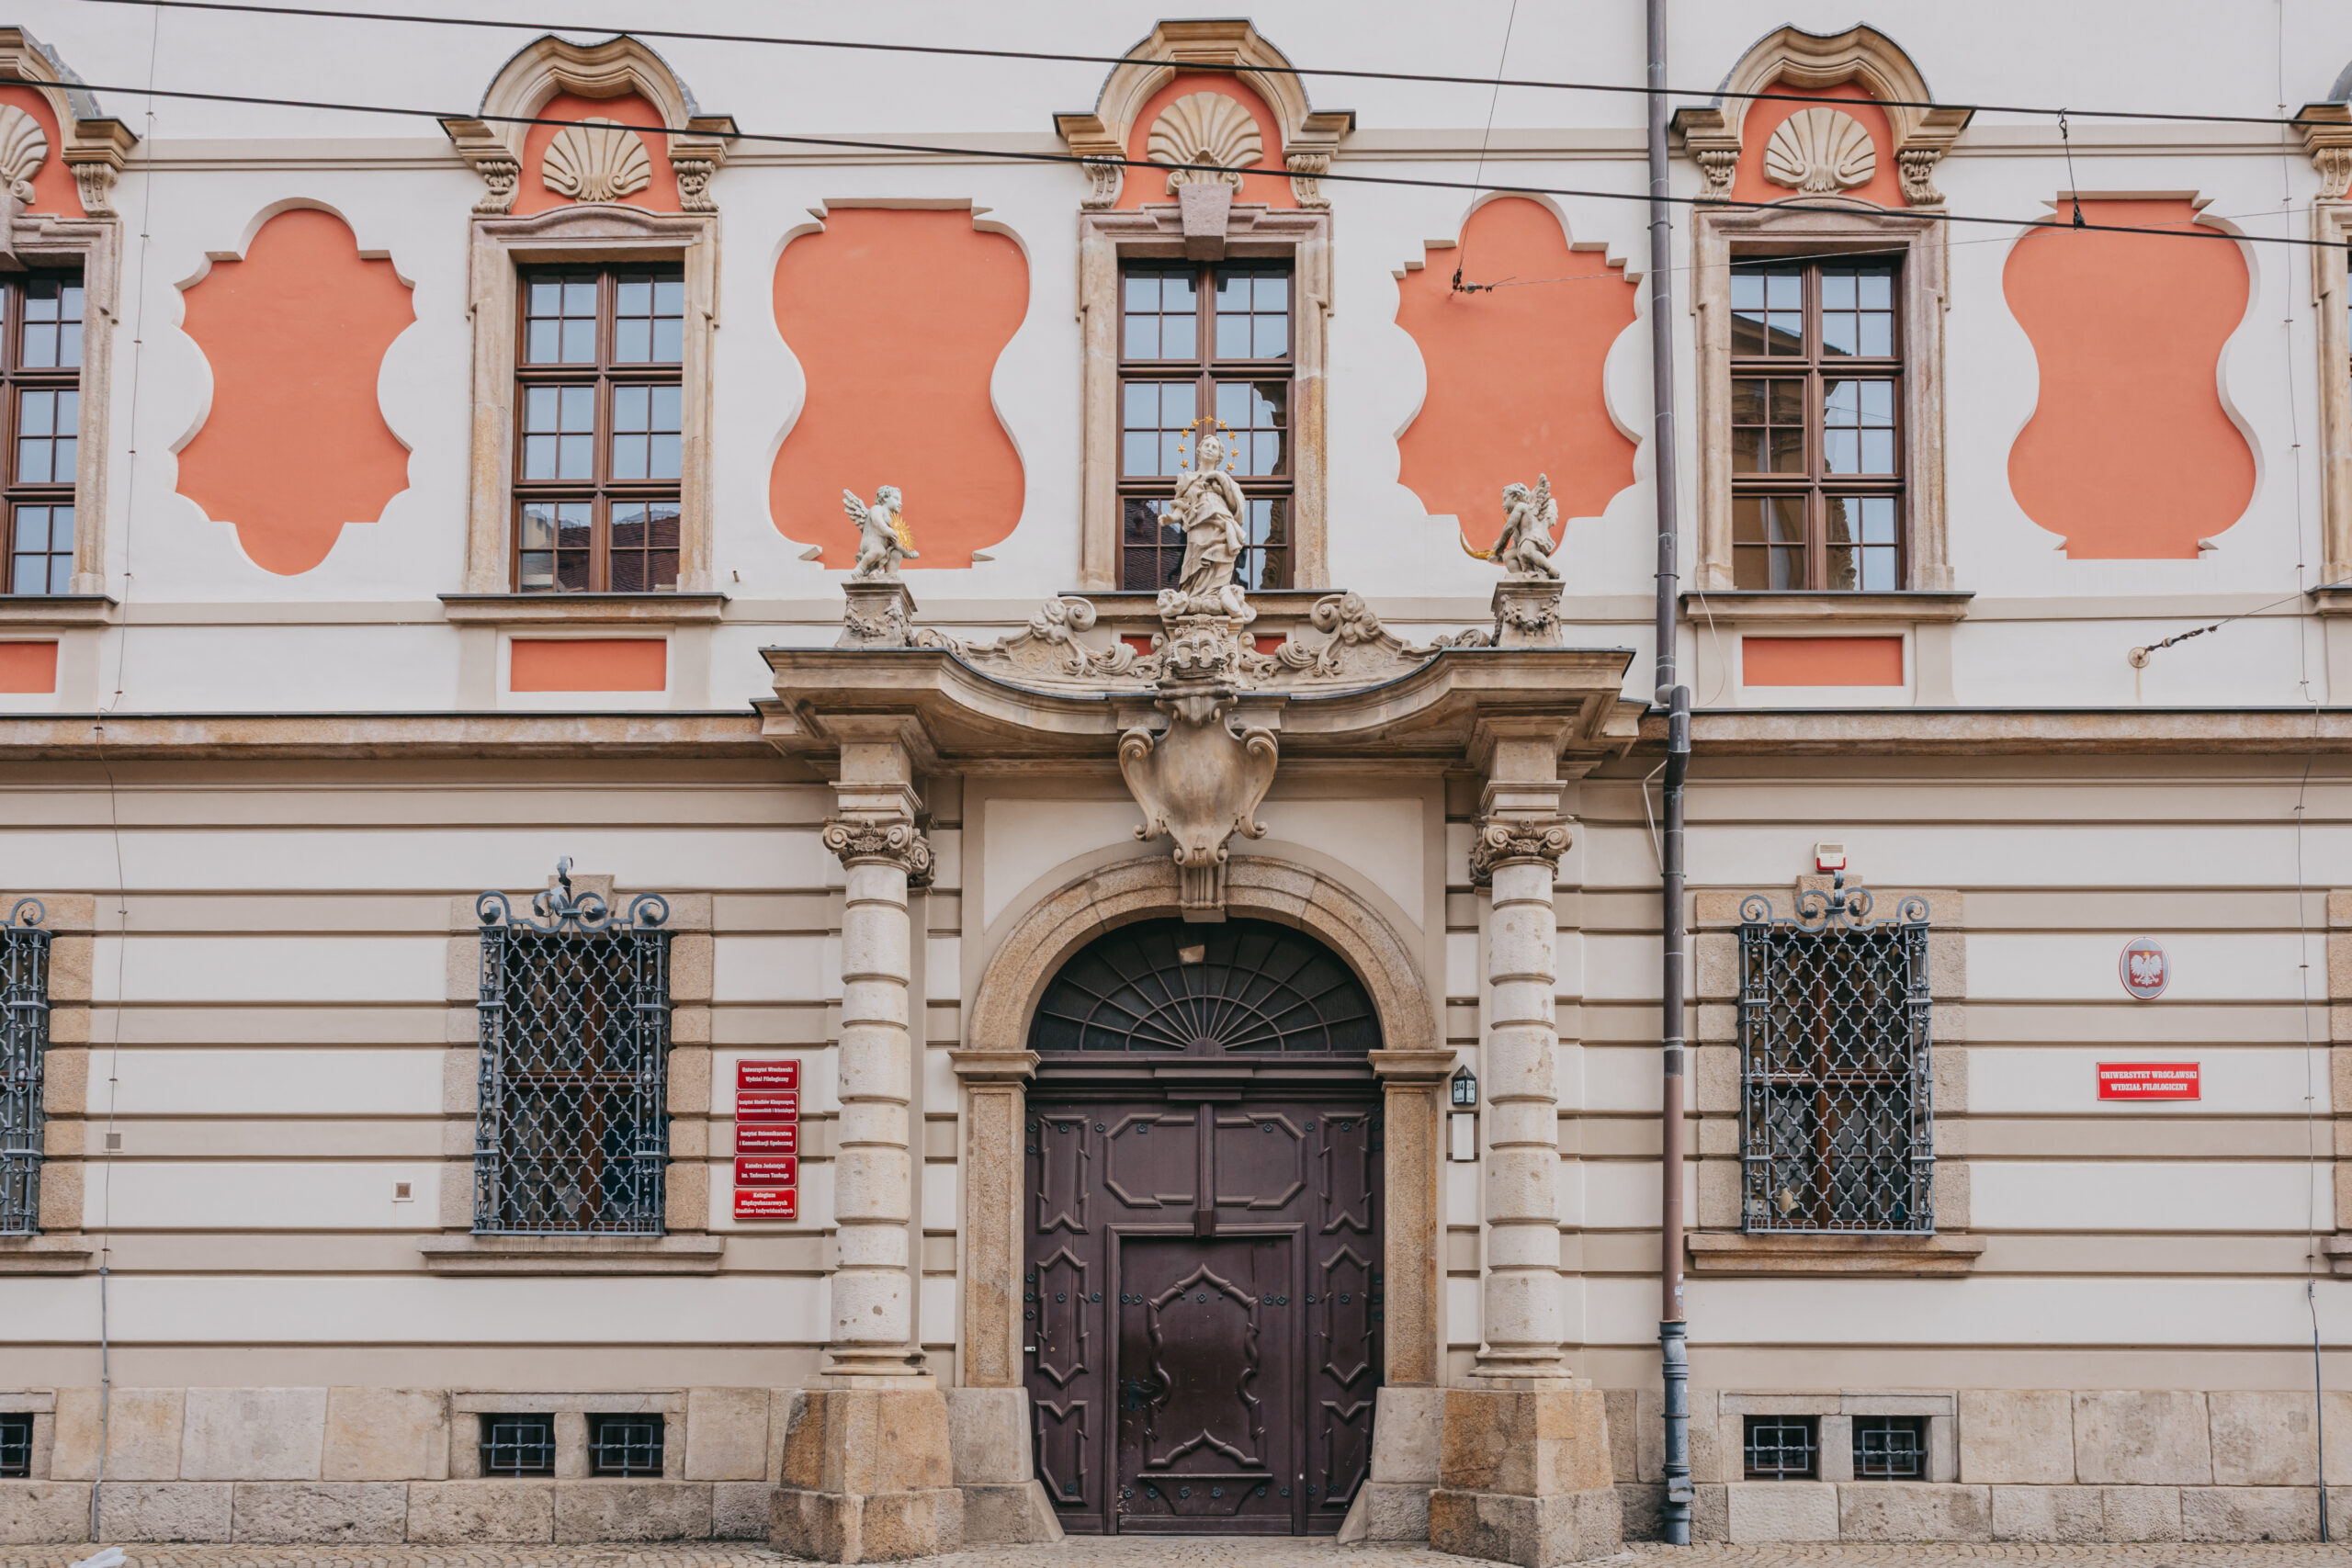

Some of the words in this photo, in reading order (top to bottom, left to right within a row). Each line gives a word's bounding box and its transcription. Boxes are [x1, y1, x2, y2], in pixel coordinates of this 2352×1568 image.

[2100, 1071, 2150, 1079] UNIWERSYTET
[2152, 1071, 2198, 1079] WROCŁAWSKI
[2110, 1083, 2142, 1091] WYDZIAŁ
[2143, 1083, 2188, 1091] FILOLOGICZNY
